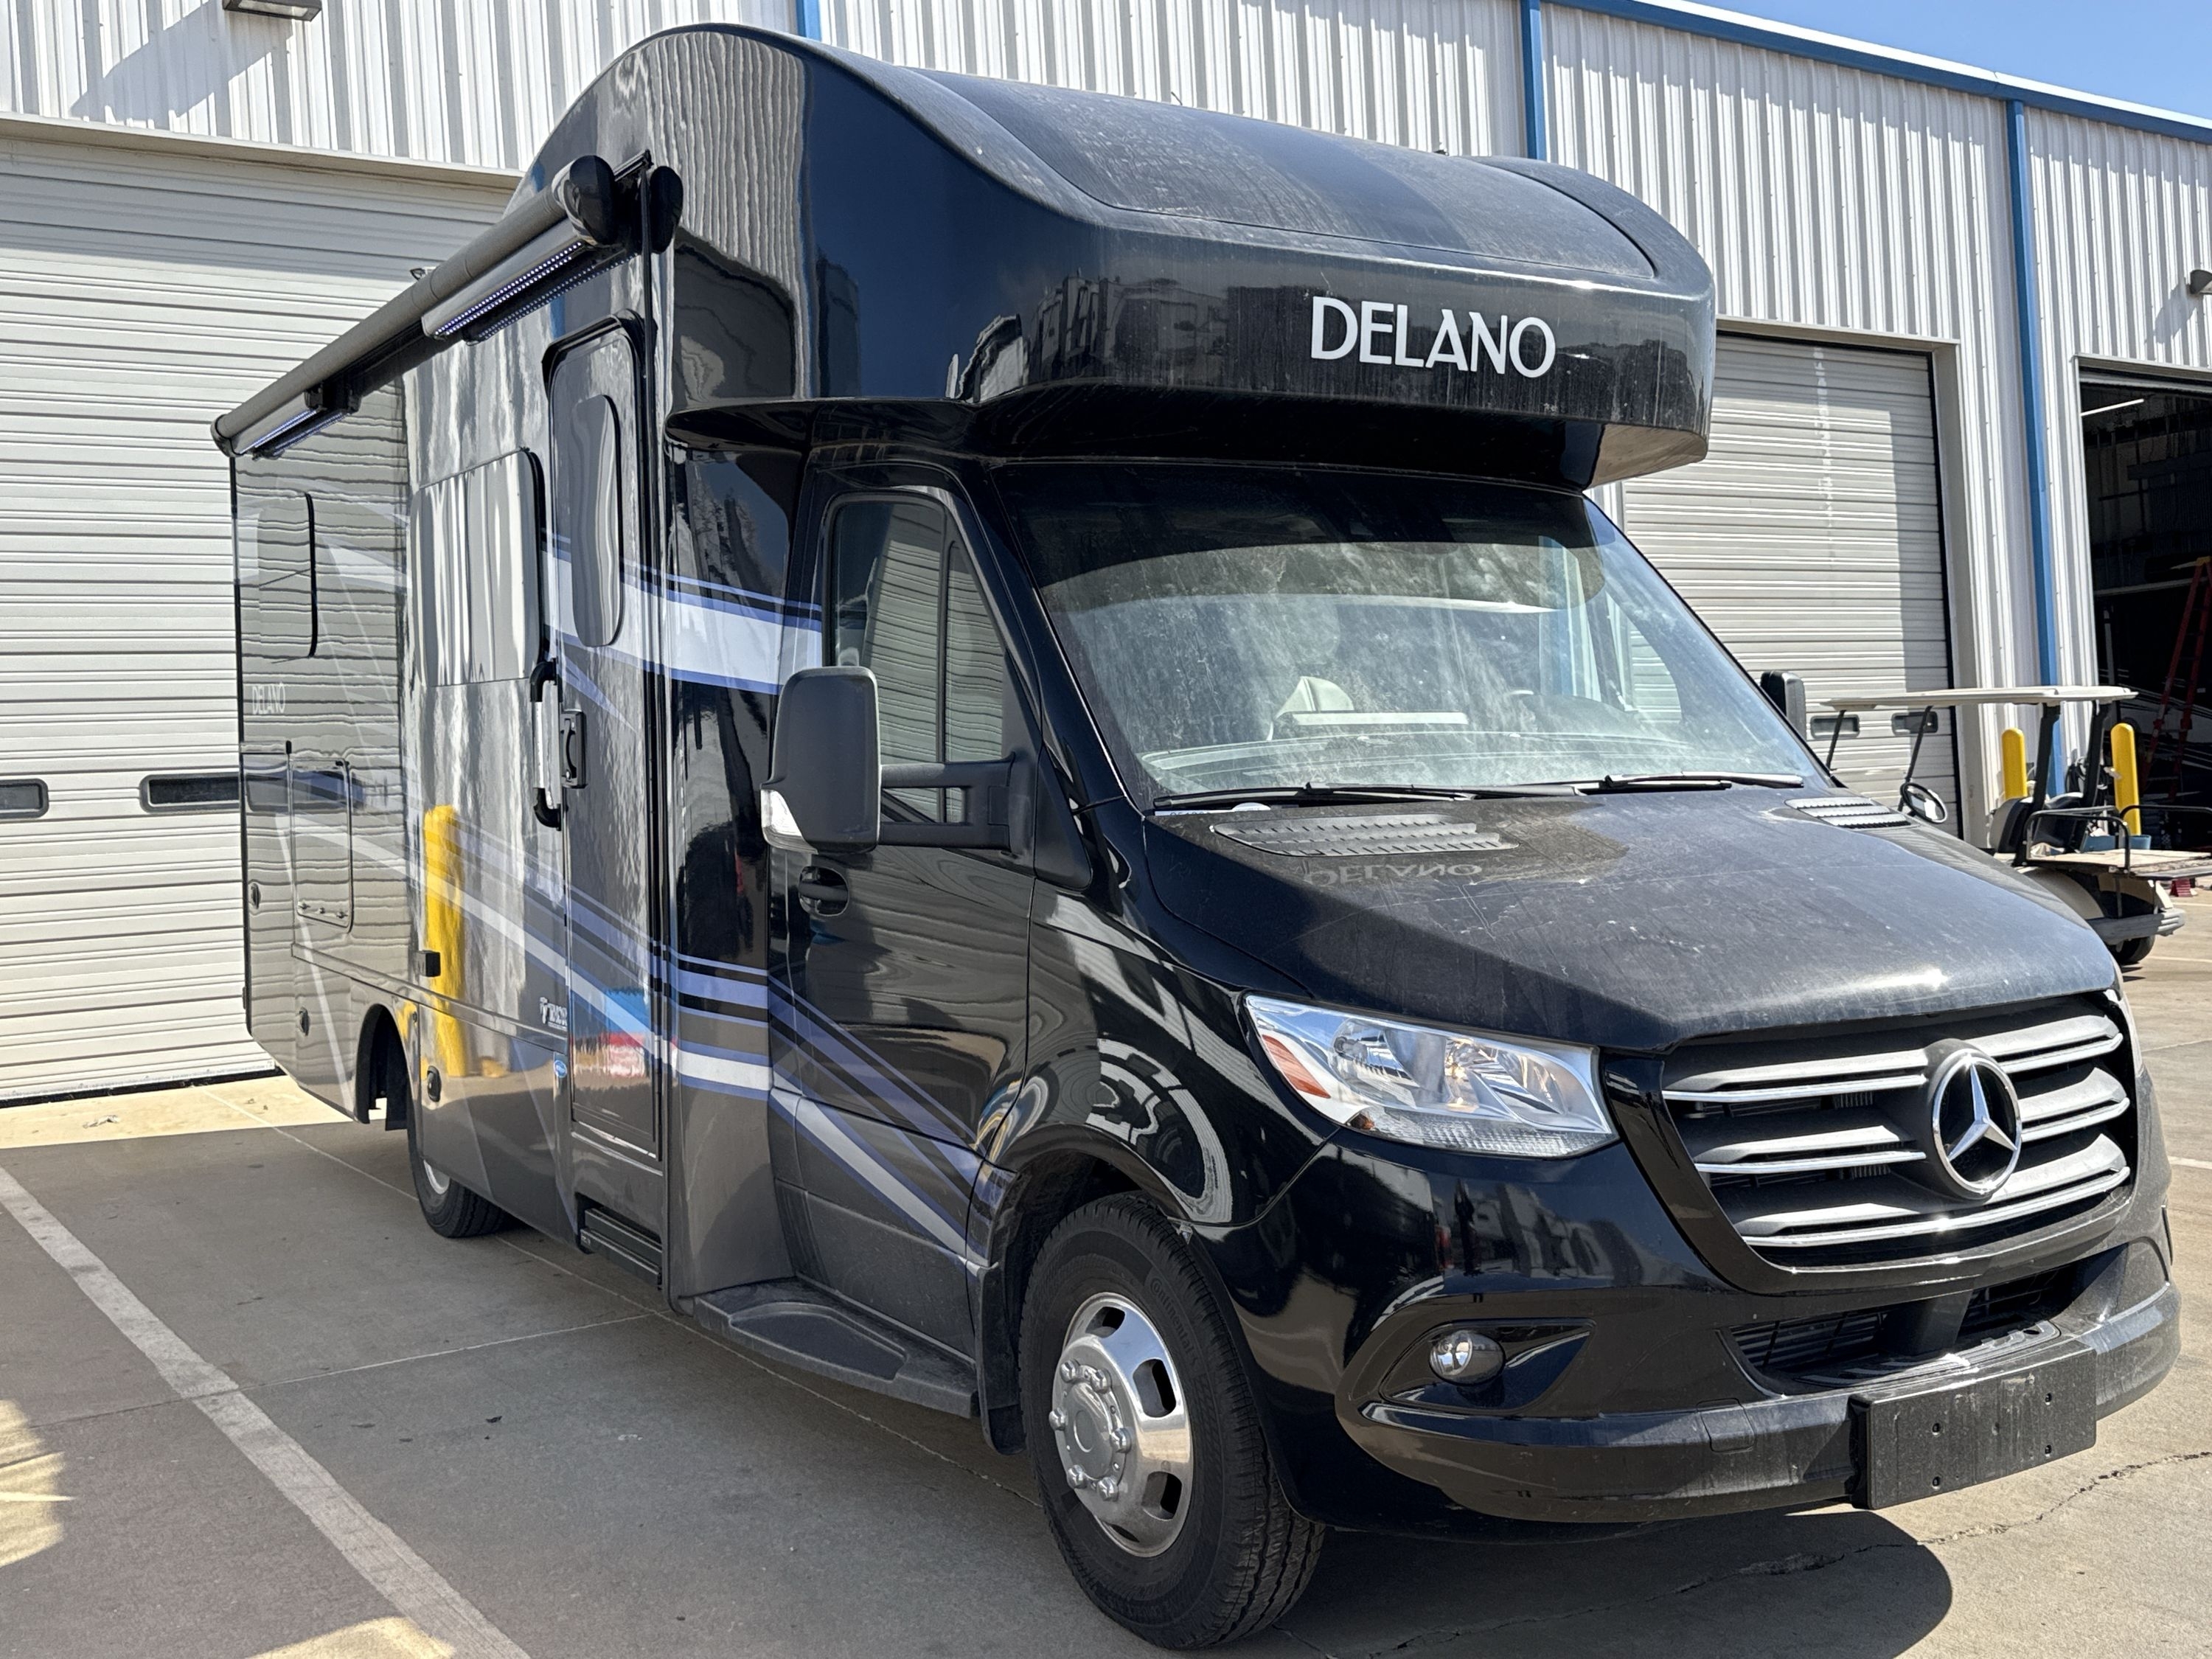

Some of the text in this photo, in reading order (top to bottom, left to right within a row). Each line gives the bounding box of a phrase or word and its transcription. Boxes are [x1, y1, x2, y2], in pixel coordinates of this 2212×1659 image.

[1311, 296, 1556, 378] DELANO
[252, 684, 286, 715] DELANO
[1150, 1277, 1194, 1354] Continental
